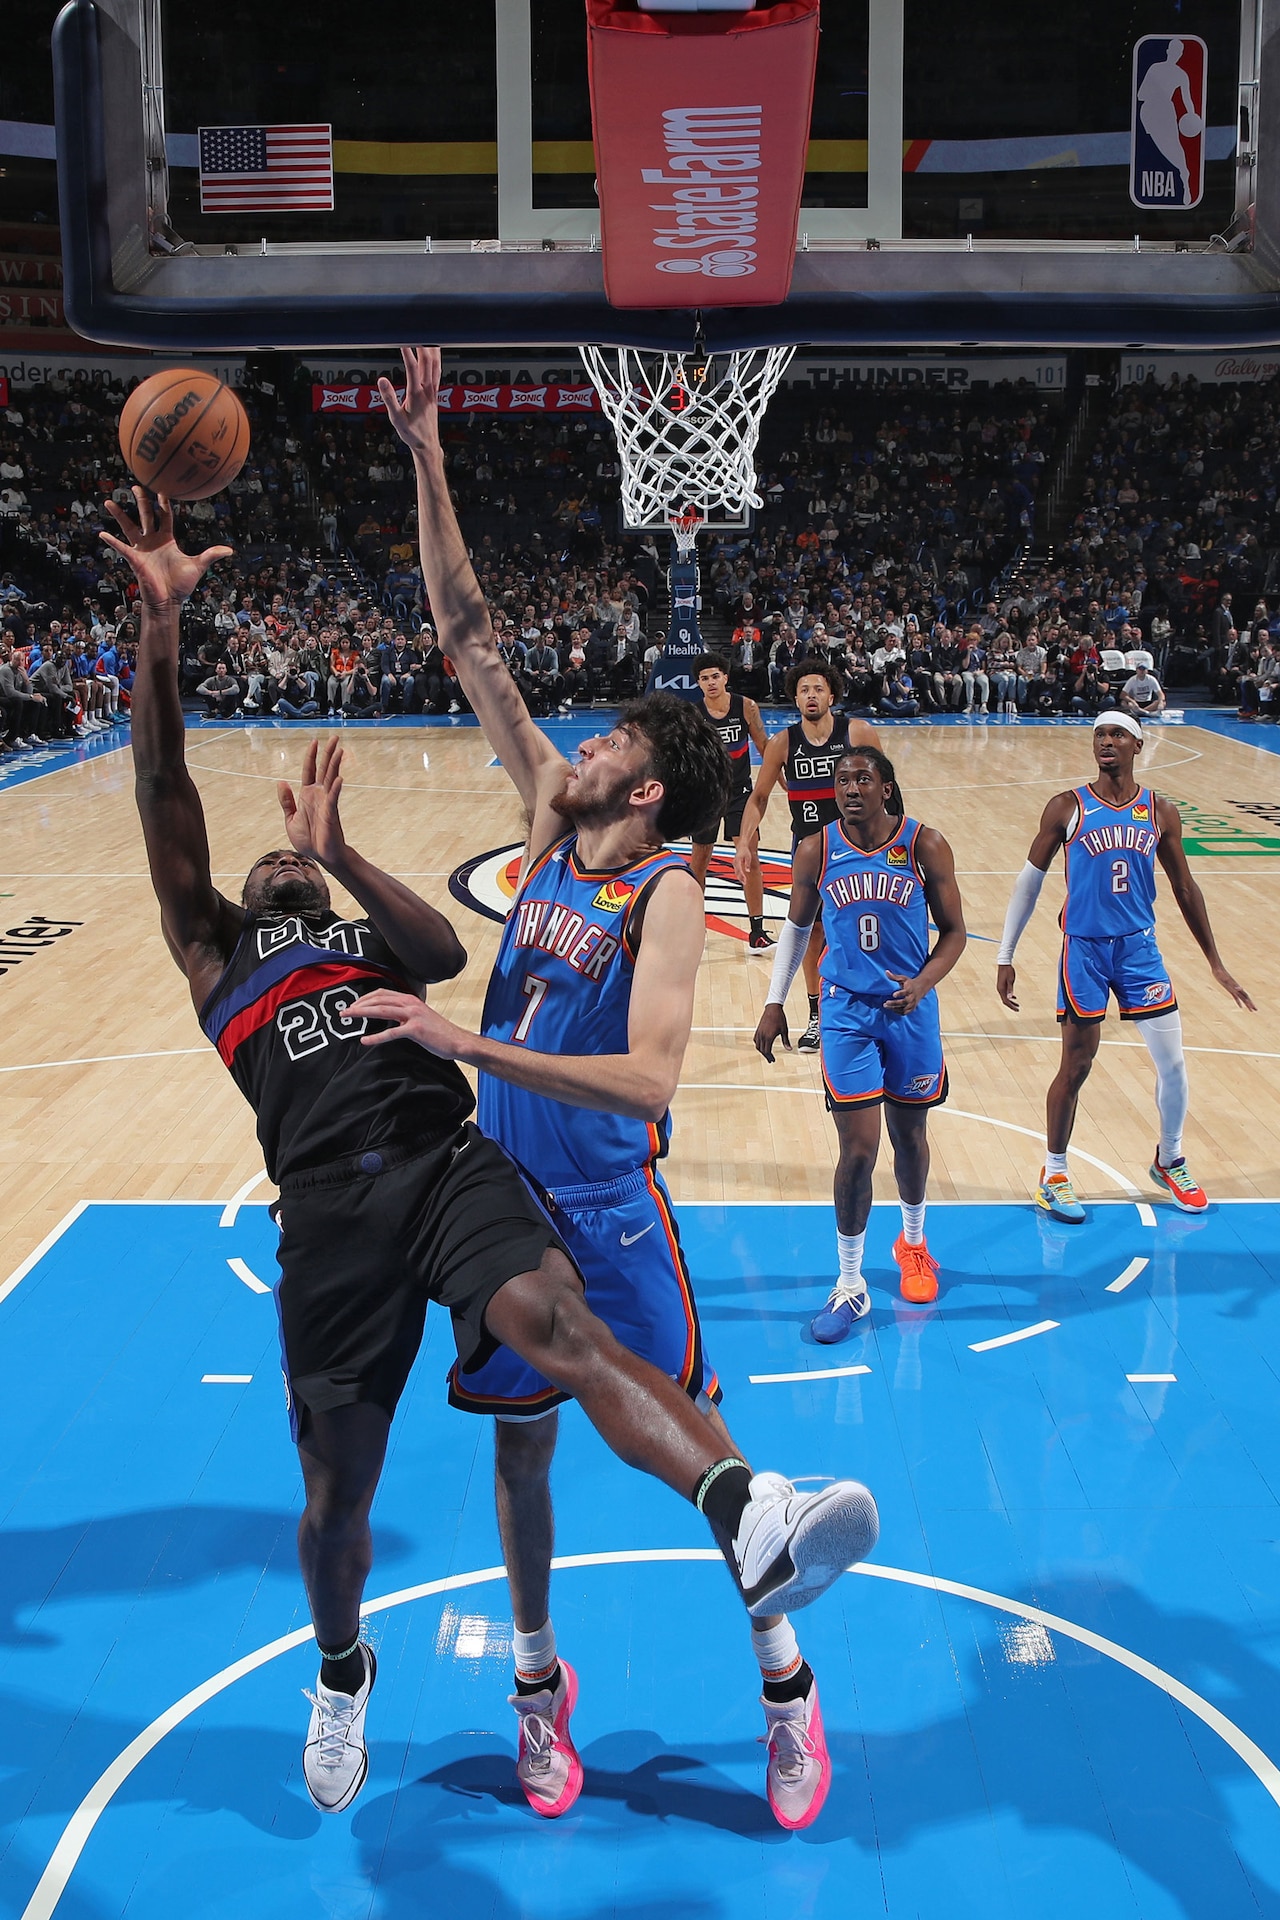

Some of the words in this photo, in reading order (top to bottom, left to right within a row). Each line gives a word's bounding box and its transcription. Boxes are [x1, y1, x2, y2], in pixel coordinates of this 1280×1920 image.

[1141, 170, 1176, 198] NBA
[806, 367, 970, 386] THUNDER
[1035, 366, 1064, 384] 101
[1214, 358, 1262, 378] Bally
[326, 394, 353, 403] SONIC
[468, 394, 494, 403] SONIC
[515, 394, 542, 403] SONIC
[562, 394, 589, 403] SONIC
[136, 391, 204, 463] Wilson
[668, 643, 701, 656] Health
[802, 801, 819, 823] 2
[1079, 825, 1156, 858] THUNDER
[1110, 859, 1129, 894] 2
[825, 872, 915, 909] THUNDER
[595, 896, 622, 911] Love's
[858, 913, 880, 952] 8
[512, 974, 549, 1043] 7
